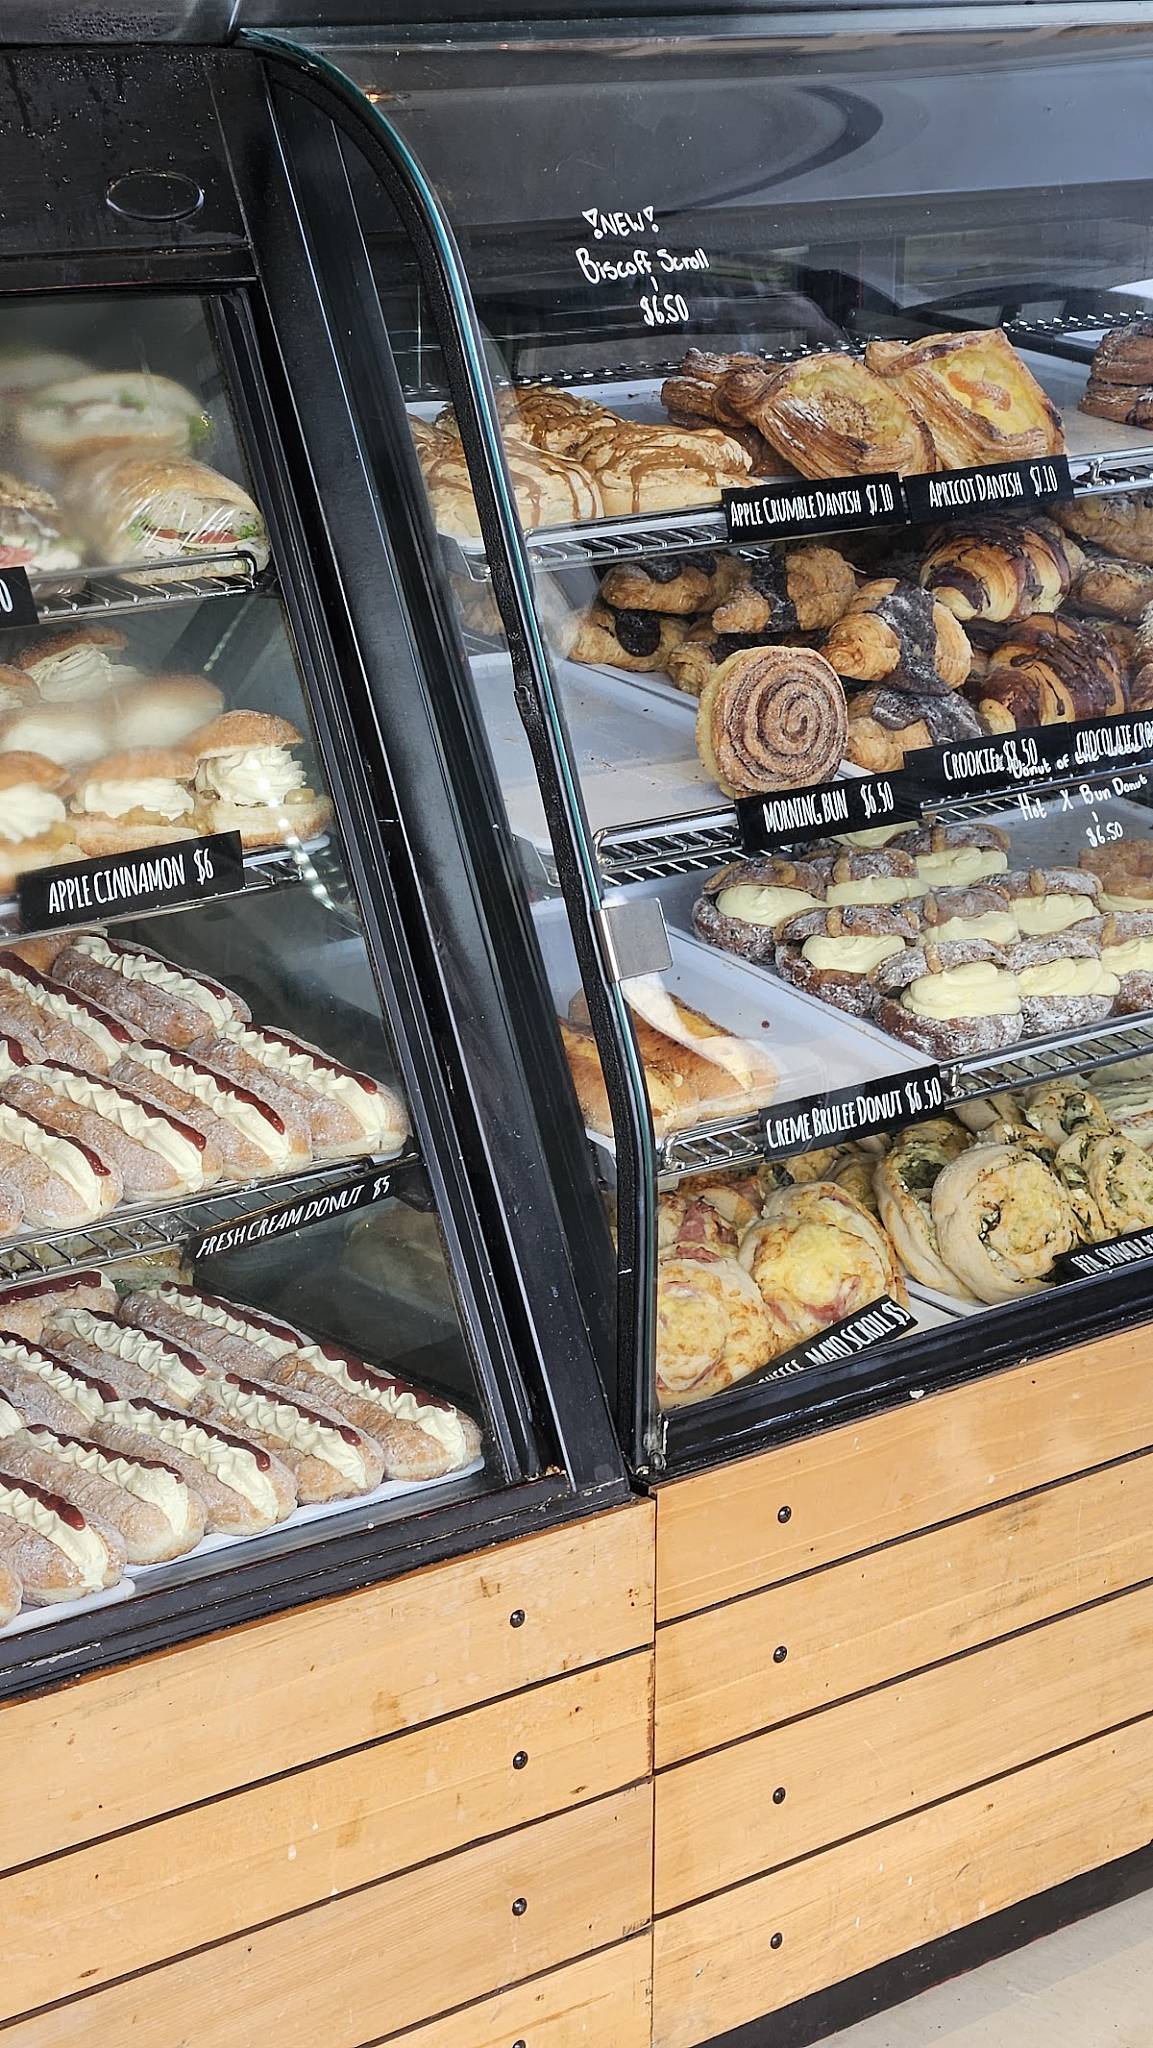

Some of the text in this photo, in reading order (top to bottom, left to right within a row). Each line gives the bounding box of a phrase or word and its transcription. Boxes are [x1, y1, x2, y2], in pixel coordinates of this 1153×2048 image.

[575, 248, 710, 284] Biscoff Scroll
[640, 294, 689, 327] $6.50
[730, 484, 895, 528] APPLE CRUMBLE DANISH $7.10
[929, 465, 1059, 508] APRICOT DANISH $7.10
[943, 737, 1038, 781] CROOKIE $8.50
[1056, 753, 1070, 770] of
[1076, 724, 1132, 757] CHOCOLATE
[762, 781, 894, 833] MORNING BUN $6.50
[1018, 774, 1147, 821] Hot X Bun Donut
[1086, 821, 1124, 847] $6.50
[48, 848, 214, 914] APPLE CINNAMON $6
[766, 1077, 942, 1150] CREME BRULEE DONUT $6.50
[196, 1175, 391, 1258] FRESH CREAM DONUT $5
[804, 1300, 911, 1366] MAYO SCROLL $5
